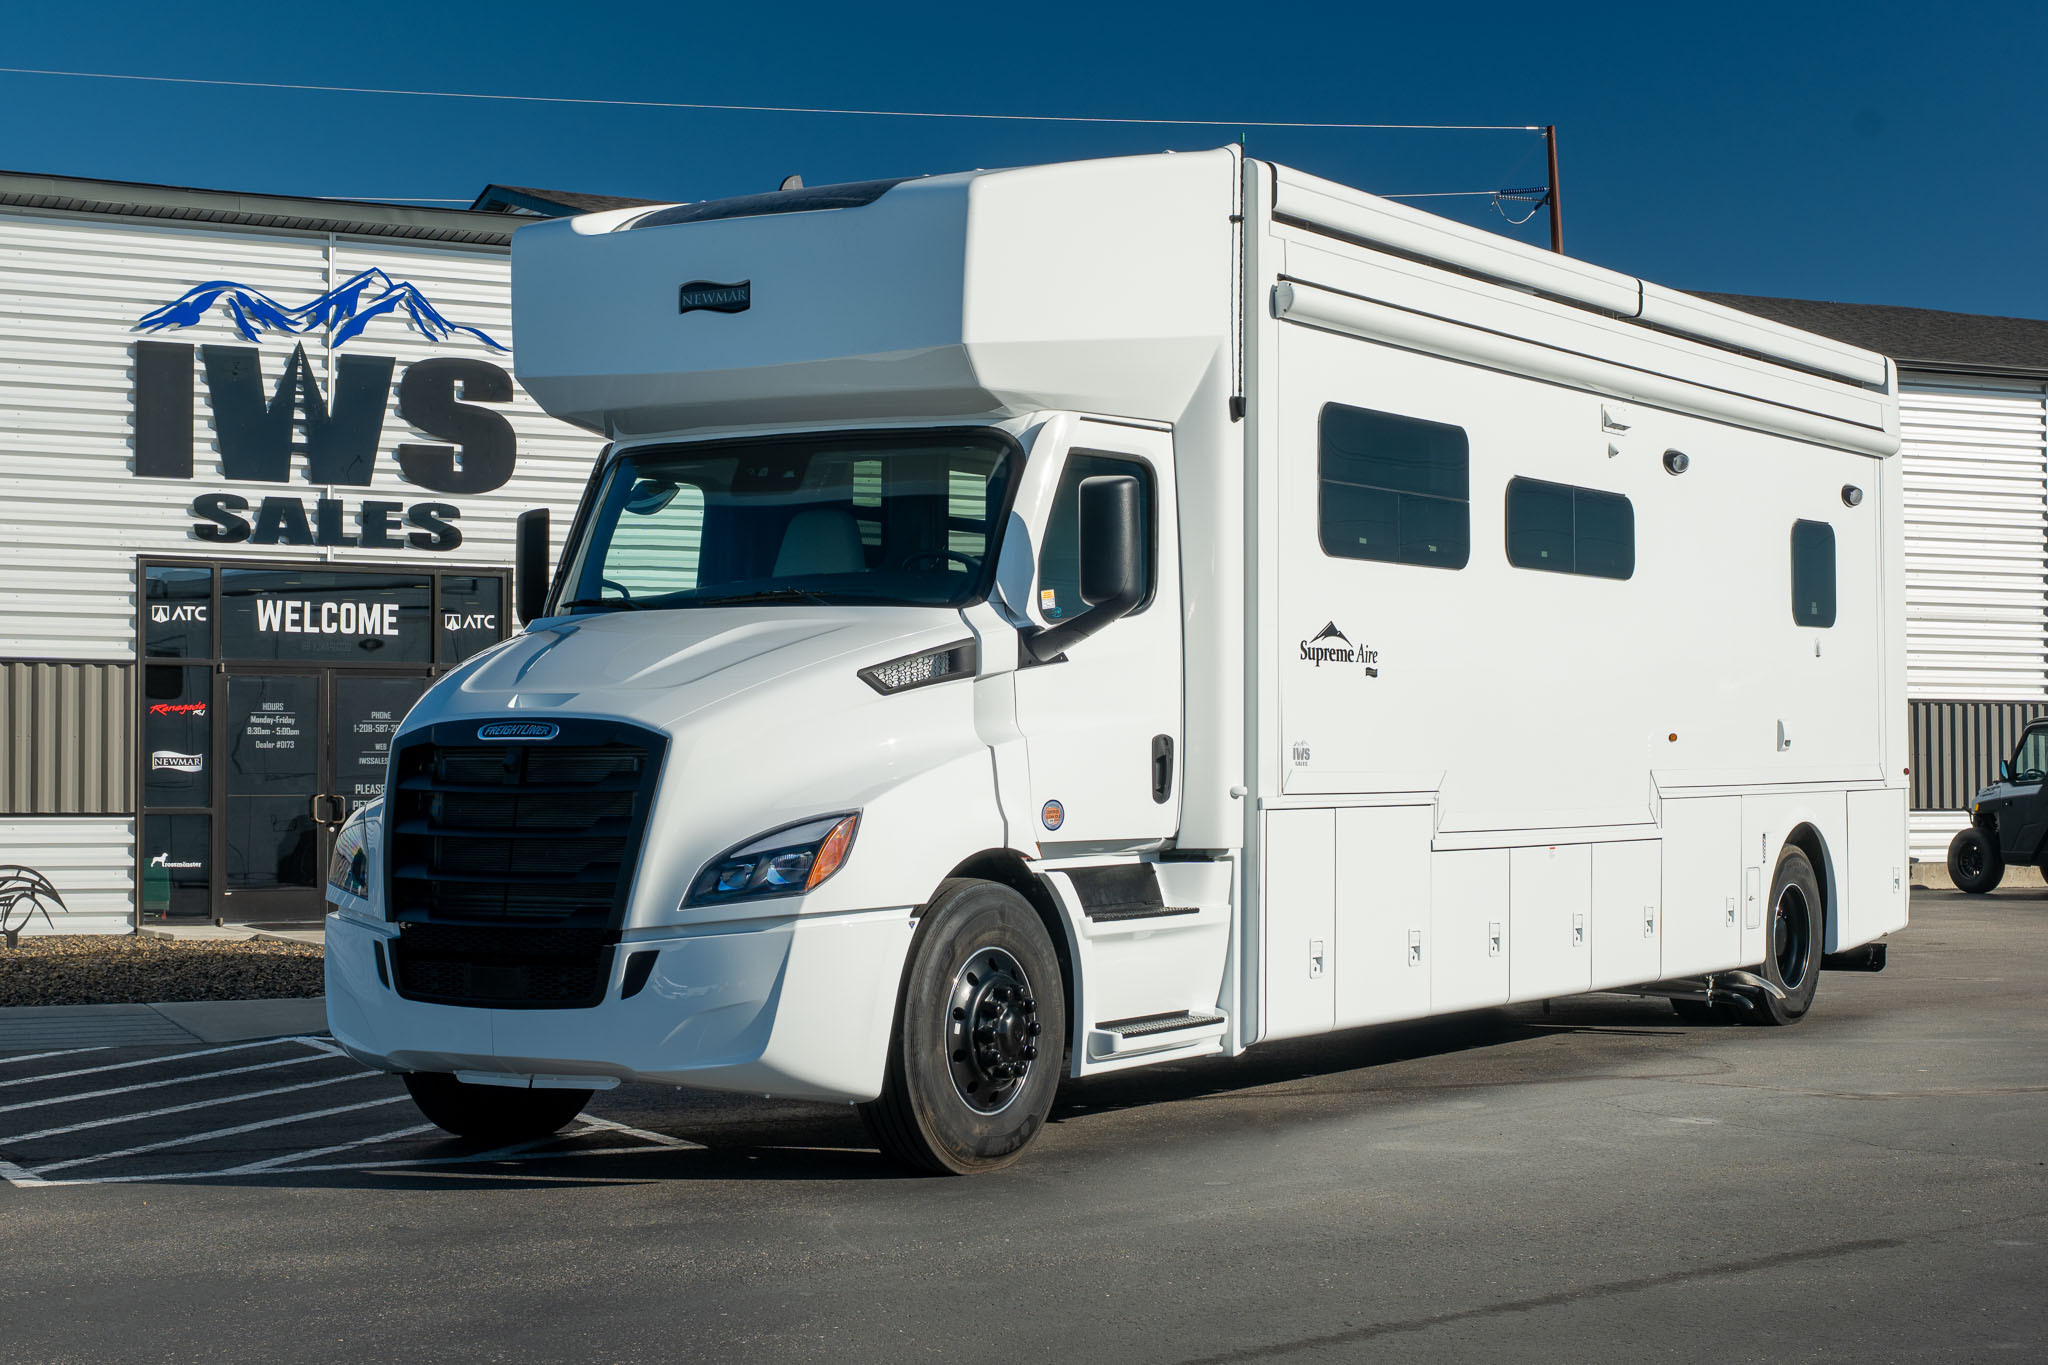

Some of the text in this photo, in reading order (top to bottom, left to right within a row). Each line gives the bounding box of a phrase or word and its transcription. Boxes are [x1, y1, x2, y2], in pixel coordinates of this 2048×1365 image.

[682, 289, 746, 305] NEWMAR
[135, 340, 517, 494] IWS
[192, 493, 463, 551] SALES
[171, 605, 207, 622] ATC
[256, 599, 399, 636] WELCOME
[463, 614, 496, 629] ATC
[1300, 639, 1378, 667] Supreme Aire
[149, 700, 206, 716] Renegade
[262, 702, 284, 711] HOURS
[250, 715, 296, 725] Monday-Friday
[371, 711, 392, 720] PHONE
[247, 726, 271, 735] 8:30am
[484, 724, 550, 736] FREIGHTLINER
[255, 740, 295, 749] Dealer #0173
[374, 743, 388, 751] WEB
[1292, 747, 1311, 761] IWS
[154, 757, 201, 767] NEWMAR
